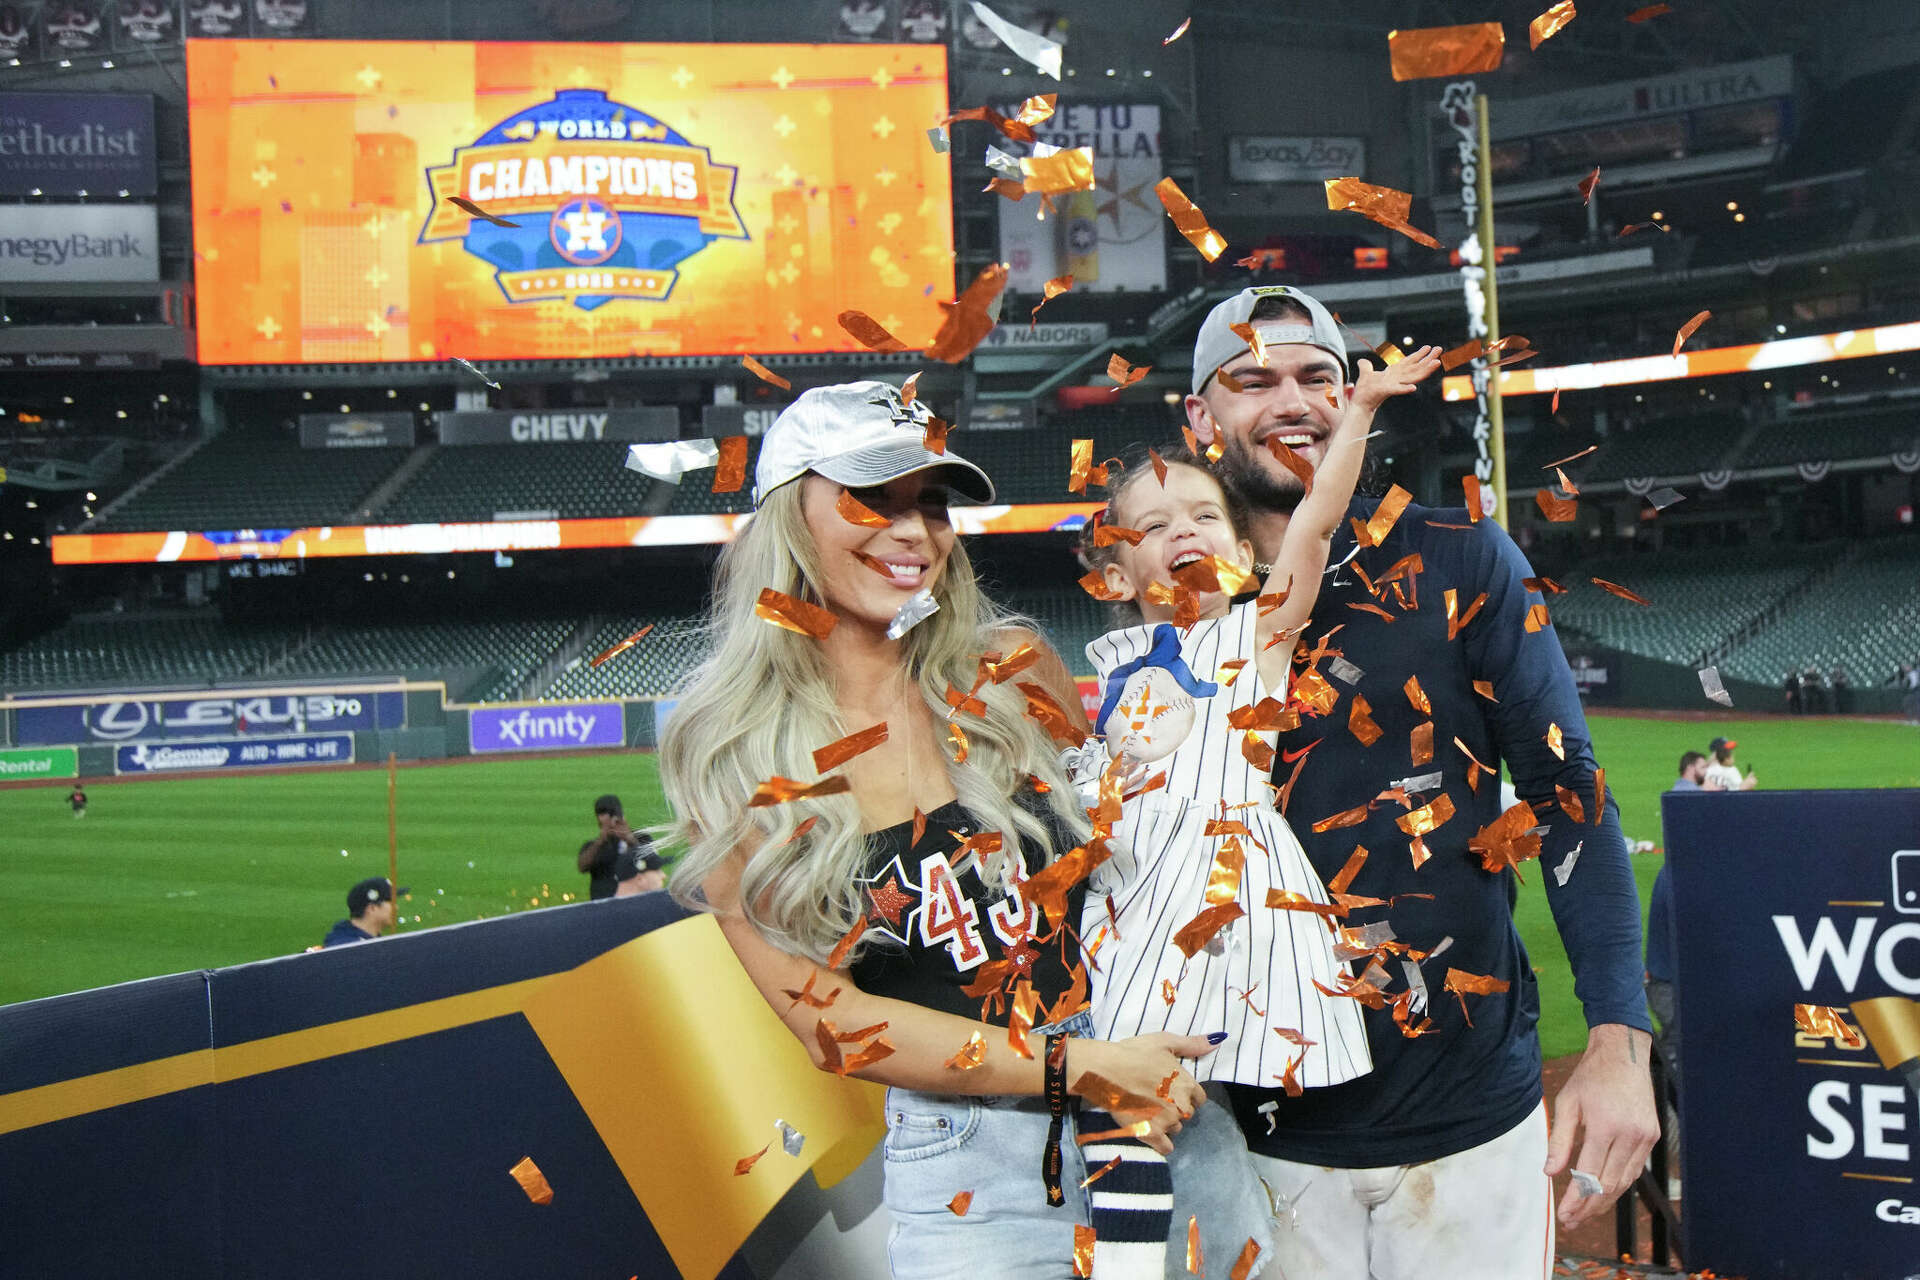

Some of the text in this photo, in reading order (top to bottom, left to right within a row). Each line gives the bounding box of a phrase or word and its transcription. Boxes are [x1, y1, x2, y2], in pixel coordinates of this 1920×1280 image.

[538, 119, 627, 139] WORLD
[1094, 105, 1132, 130] TU
[0, 123, 138, 156] ethodist
[469, 155, 698, 202] CHAMPIONS
[565, 211, 608, 251] H
[1013, 327, 1091, 344] NABORS
[511, 414, 608, 441] CHEVY
[154, 697, 362, 726] LEXUS 370
[499, 710, 596, 746] xfinity
[0, 758, 52, 774] Rental
[1771, 914, 1920, 996] WO
[1806, 1080, 1920, 1161] SE
[1875, 1198, 1920, 1225] Ca
